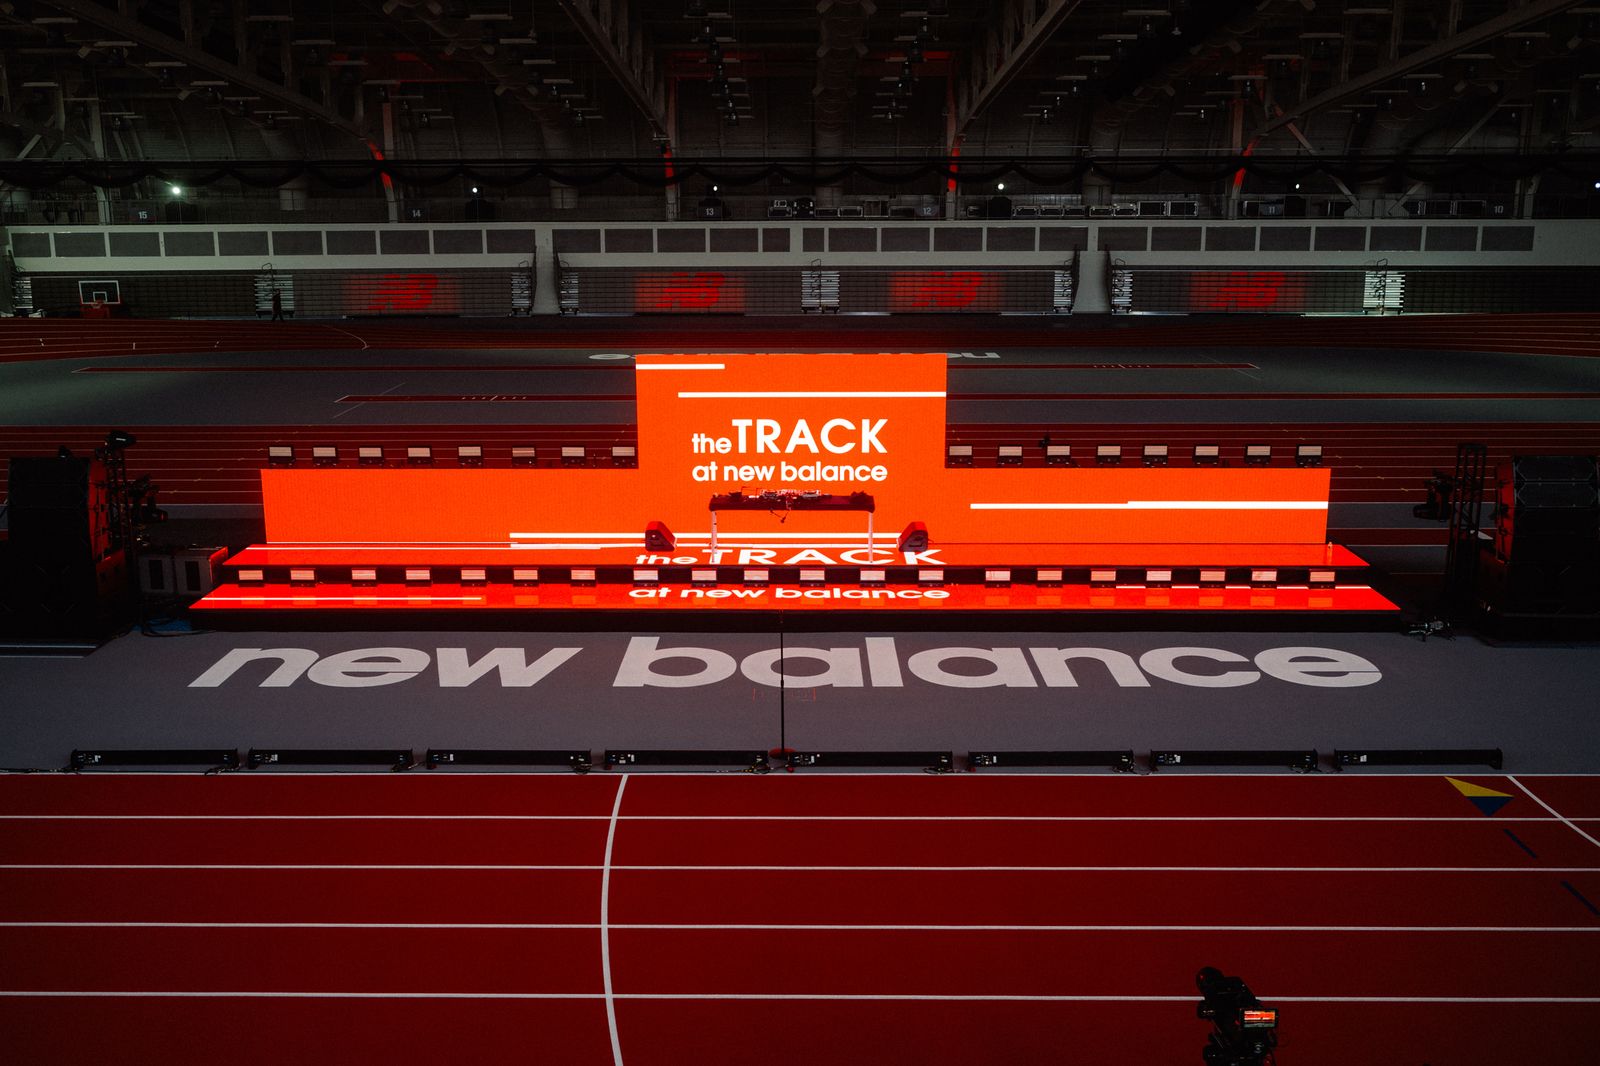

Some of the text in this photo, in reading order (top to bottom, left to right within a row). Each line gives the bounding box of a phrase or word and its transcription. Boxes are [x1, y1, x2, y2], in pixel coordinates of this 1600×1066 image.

[412, 209, 421, 217] 14
[706, 207, 715, 216] 13
[923, 207, 932, 215] 12
[1494, 205, 1504, 214] 10
[138, 211, 148, 219] 15
[691, 418, 888, 454] the TRACK
[691, 460, 888, 482] at new balance
[635, 549, 946, 565] the TRACK
[628, 587, 951, 599] at new balance
[187, 636, 1383, 688] new balance
